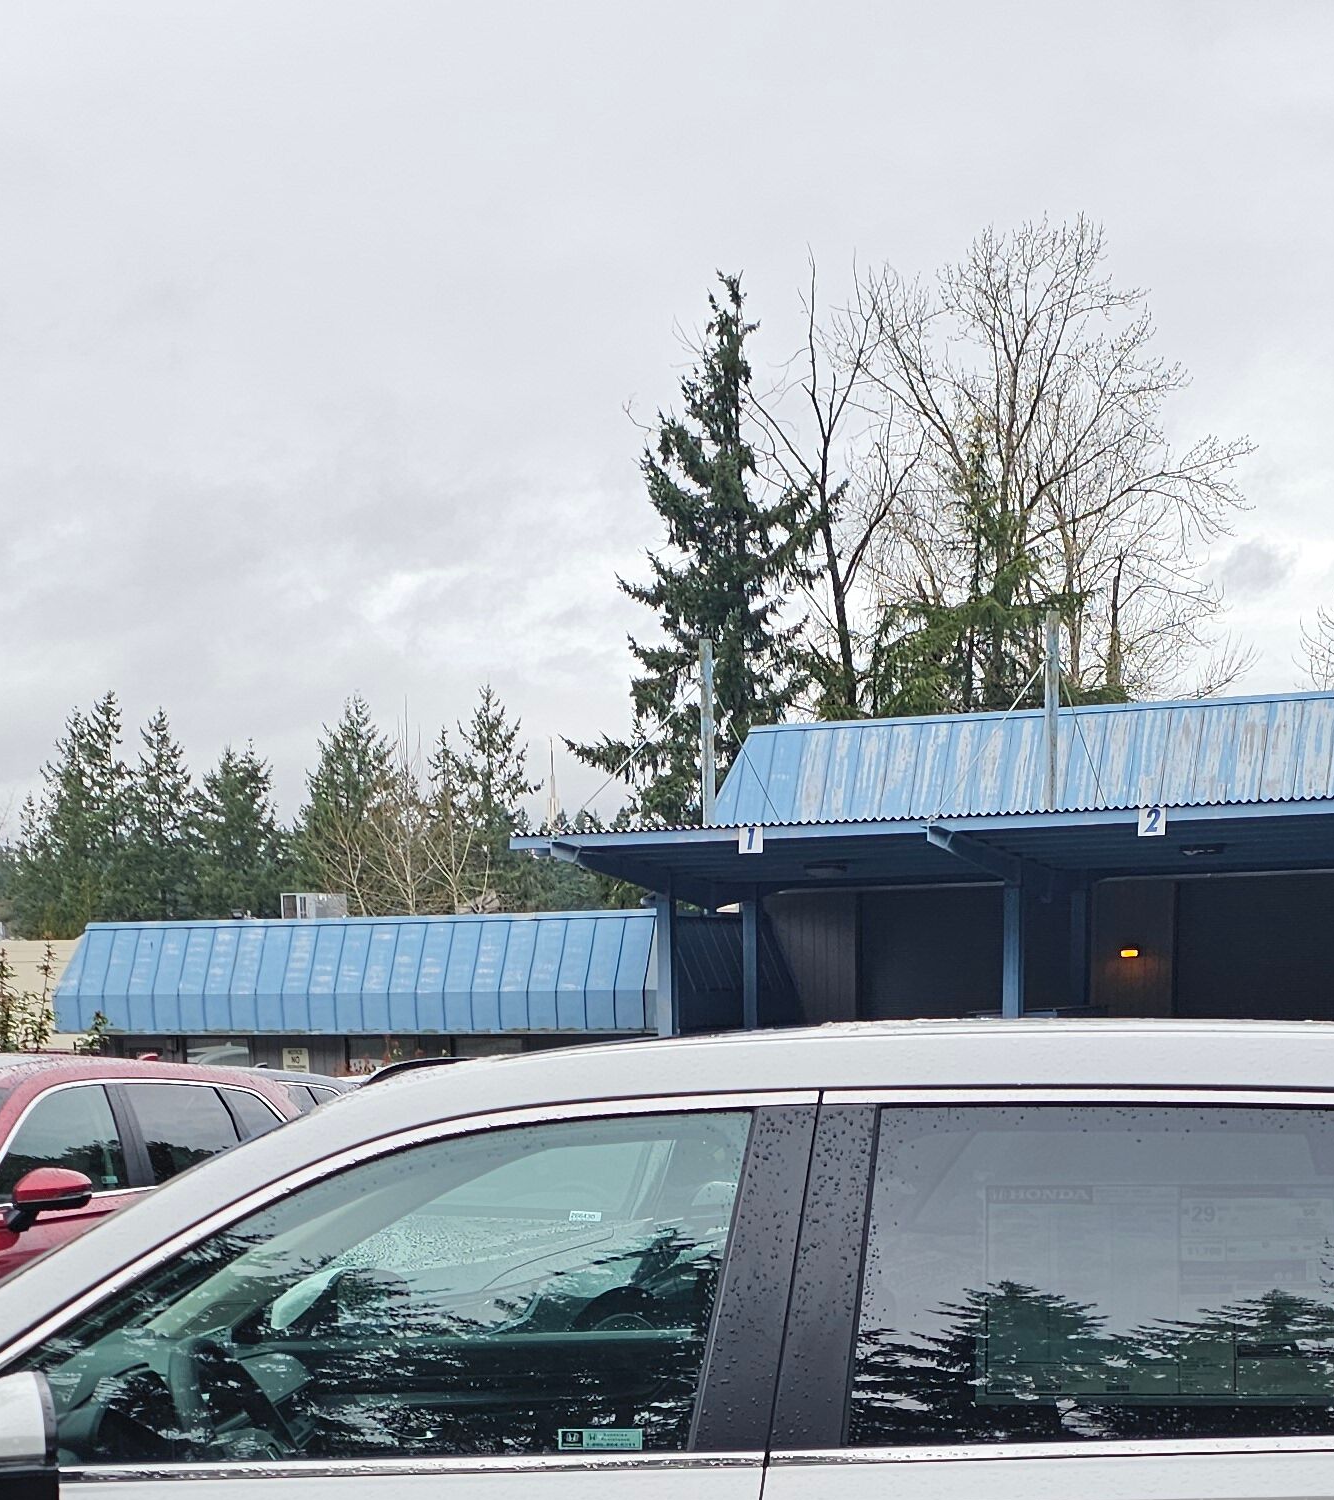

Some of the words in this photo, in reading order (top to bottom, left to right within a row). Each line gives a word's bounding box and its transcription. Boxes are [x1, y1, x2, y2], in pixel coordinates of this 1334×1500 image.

[1144, 808, 1161, 833] 2
[747, 827, 756, 851] 1
[1009, 1188, 1090, 1201] HONDA
[1190, 1205, 1217, 1223] 29
